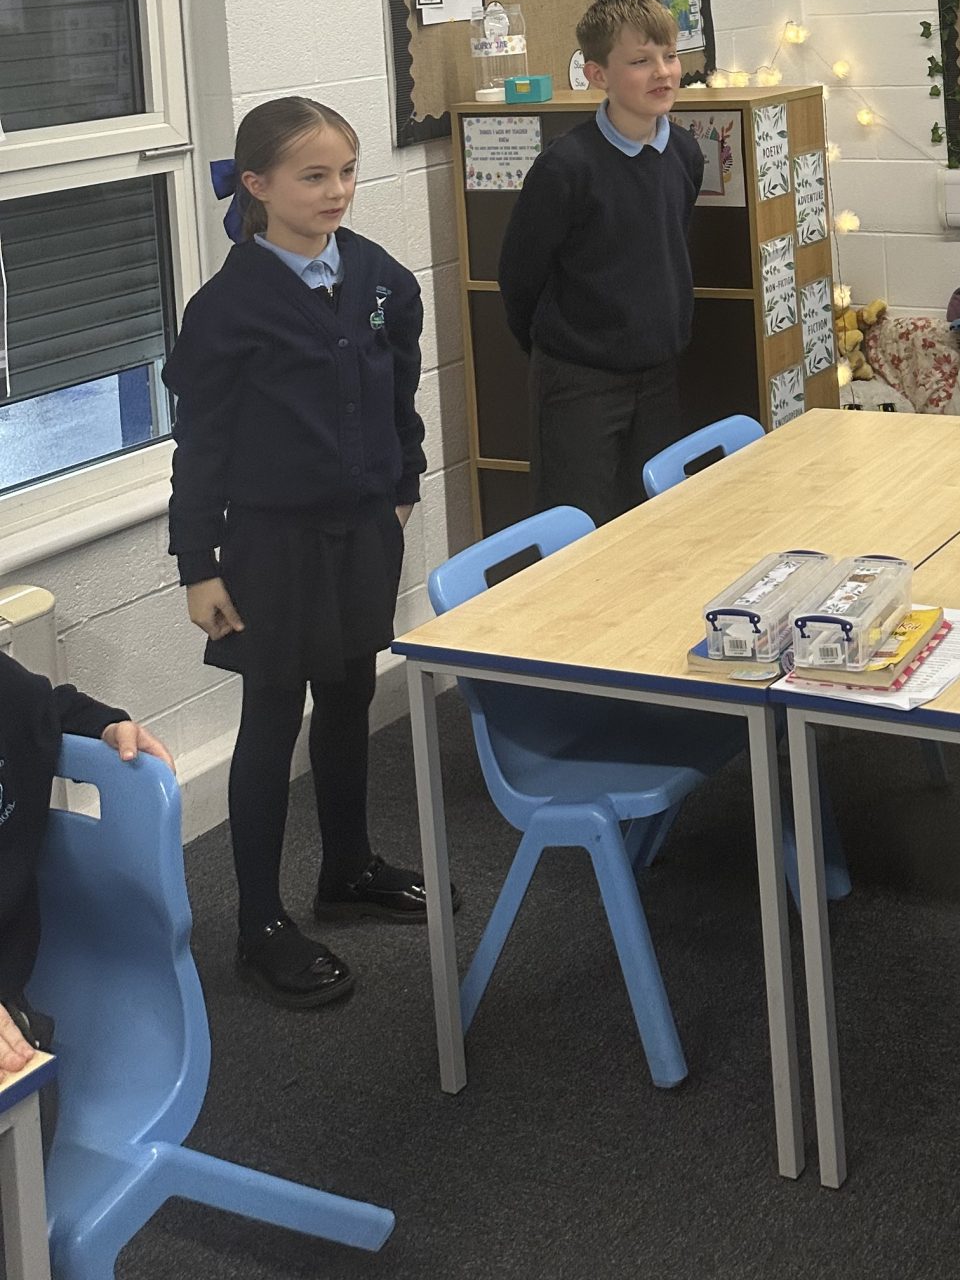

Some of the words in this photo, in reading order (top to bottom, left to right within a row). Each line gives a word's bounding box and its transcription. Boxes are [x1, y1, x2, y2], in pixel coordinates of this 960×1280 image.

[473, 41, 493, 50] WORRY
[575, 78, 585, 87] Six
[763, 144, 783, 159] POETRY
[797, 190, 824, 206] ADVENTURE
[765, 276, 794, 294] NON-FICTION
[807, 318, 828, 336] FICTION
